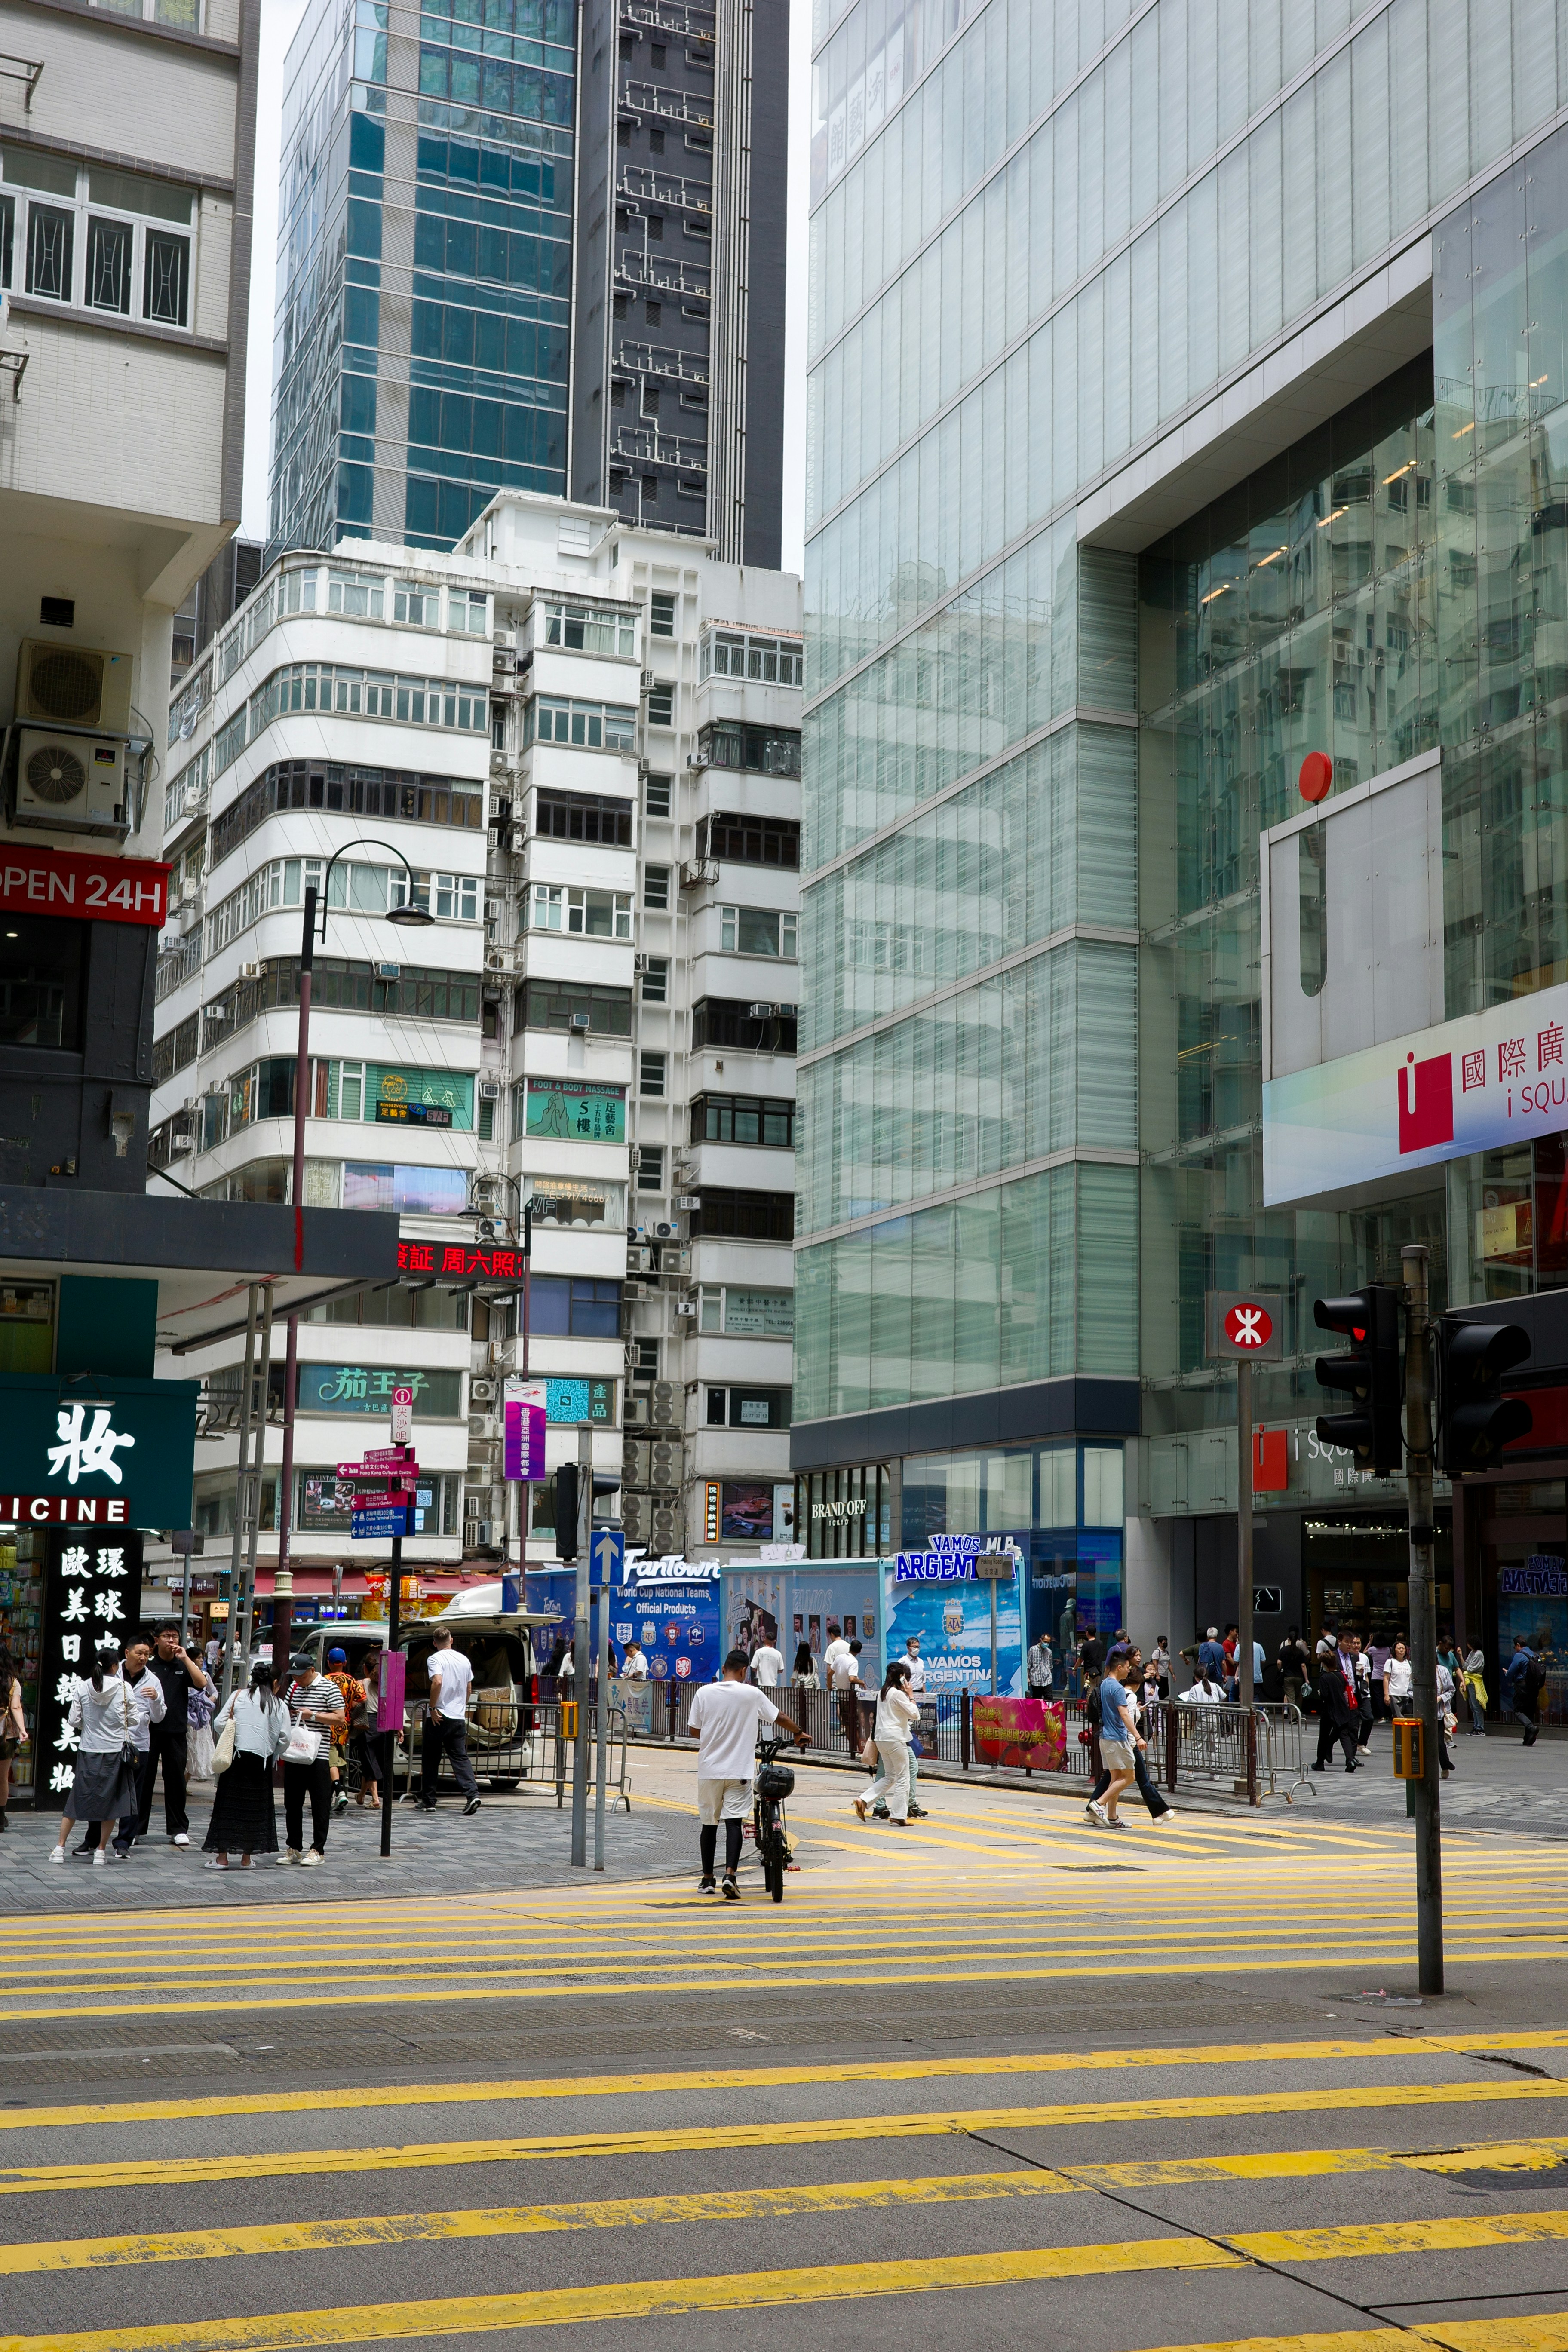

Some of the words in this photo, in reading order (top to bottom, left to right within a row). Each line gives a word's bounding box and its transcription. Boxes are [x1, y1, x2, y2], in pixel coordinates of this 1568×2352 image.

[0, 866, 75, 903] PEN
[85, 875, 160, 913] 24H
[1462, 1021, 1565, 1094] 國際廣
[533, 1080, 553, 1089] FOOT
[555, 1082, 561, 1090] &
[563, 1083, 583, 1092] BODY
[586, 1085, 620, 1095] MASSAGE
[1521, 1076, 1568, 1115] SQU
[381, 1108, 407, 1118] 足藝舍
[577, 1101, 591, 1133] 5樓
[593, 1096, 601, 1139] 二十五年品牌
[605, 1102, 616, 1135] 足藝舍
[442, 1248, 522, 1278] 周六照
[592, 1384, 607, 1418] 產品
[396, 1407, 407, 1441] 尖沙咀
[520, 1407, 530, 1475] 香港亞洲國際都會
[1307, 1430, 1354, 1465] SQ
[0, 1497, 125, 1522] ICINE
[812, 1501, 845, 1518] BRAND
[847, 1499, 867, 1516] OFF
[932, 1535, 980, 1553] VAMOS
[984, 1567, 999, 1576] 北京道
[617, 1586, 637, 1598] World
[639, 1587, 653, 1600] Cup
[655, 1586, 684, 1598] National
[687, 1586, 709, 1598] Teams
[636, 1602, 662, 1614] Official
[663, 1603, 696, 1615] Products
[947, 1617, 960, 1631] AFA
[927, 1655, 981, 1669] VAMOS
[924, 1668, 992, 1684] RGENTINA
[951, 1680, 980, 1694] jutos
